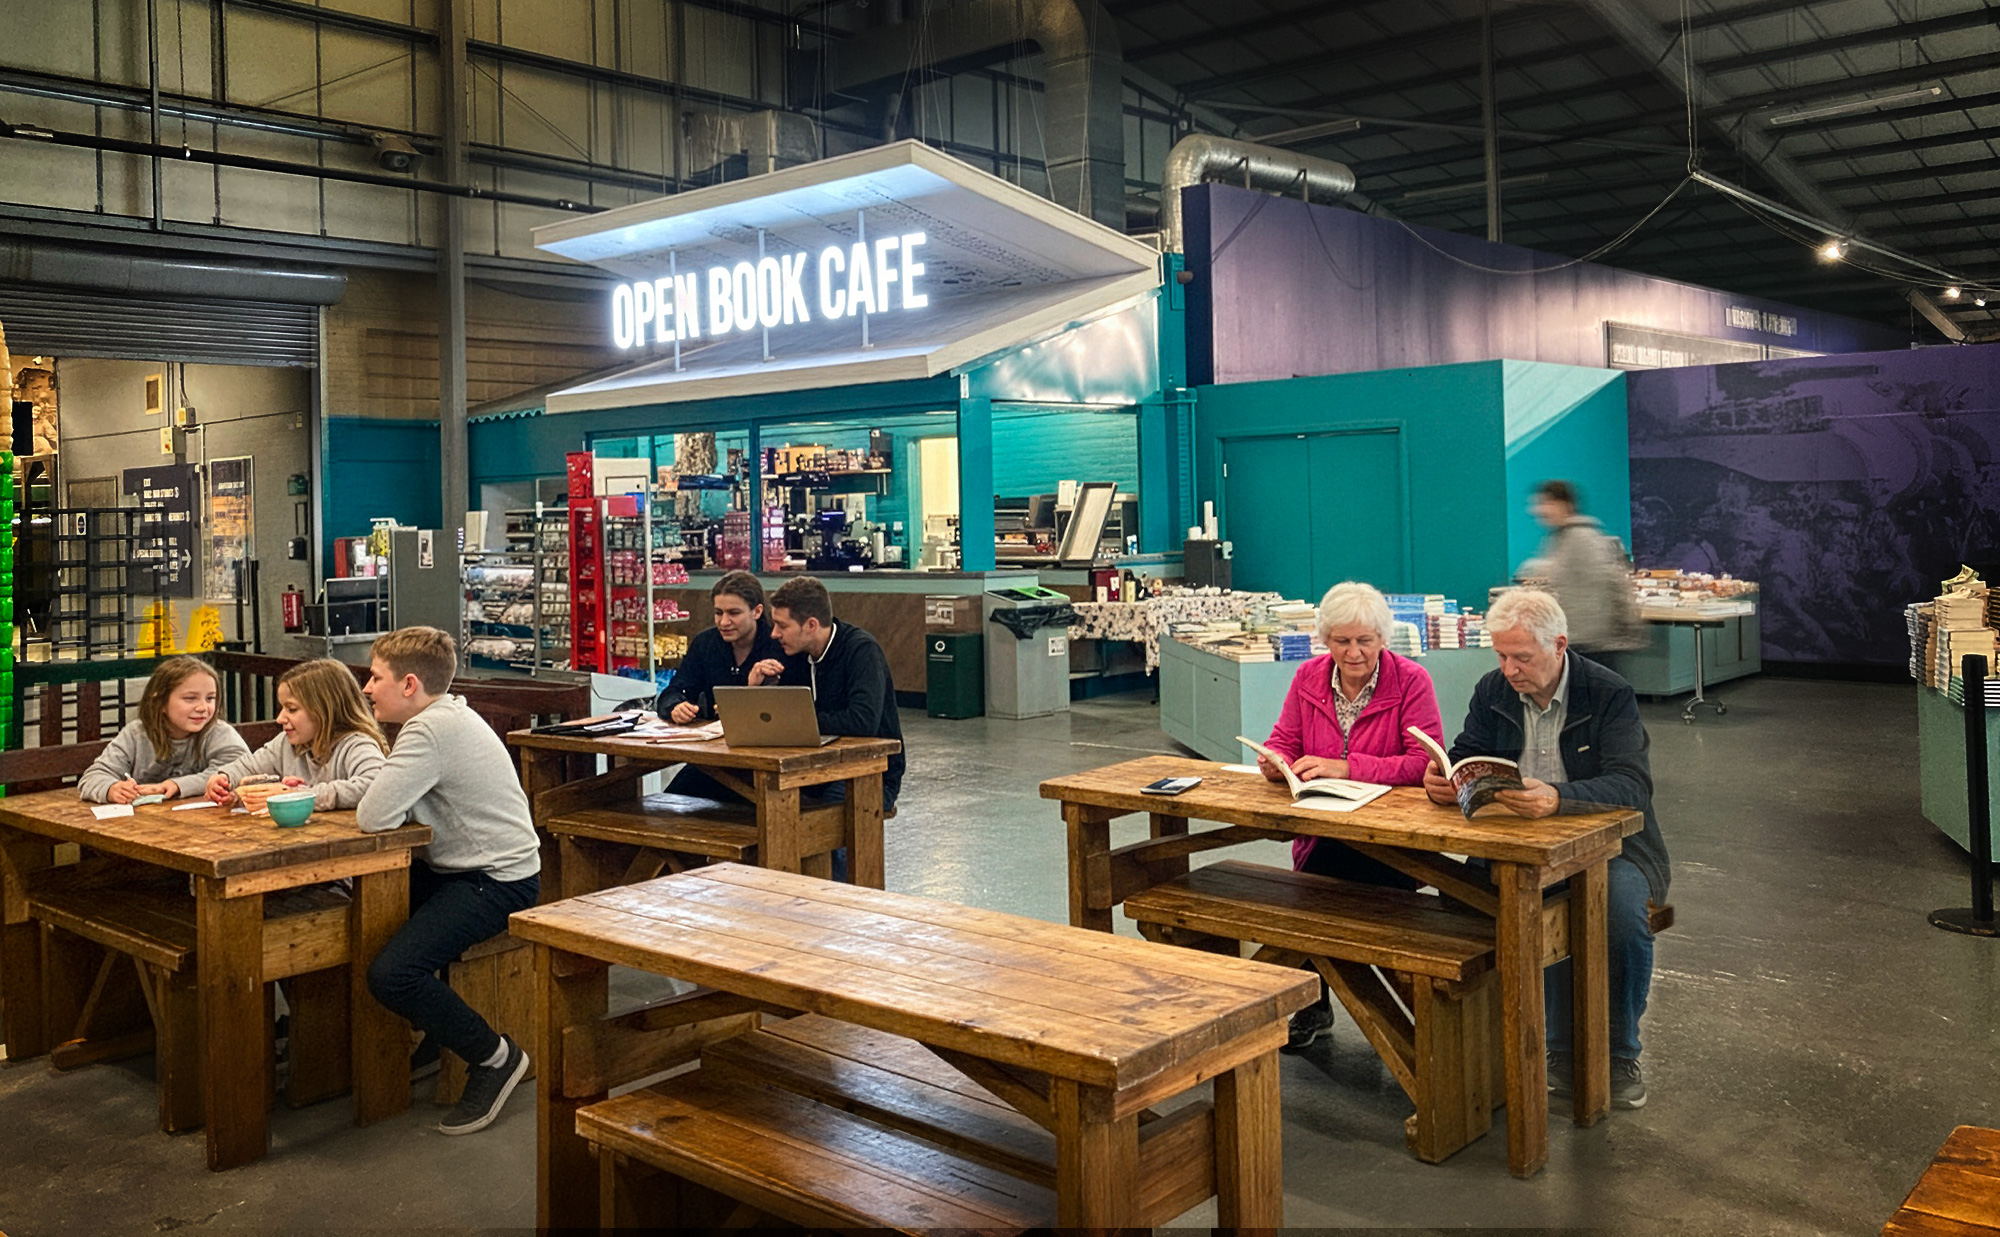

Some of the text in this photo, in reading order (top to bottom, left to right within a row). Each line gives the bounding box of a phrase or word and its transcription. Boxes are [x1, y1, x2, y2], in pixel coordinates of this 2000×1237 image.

[612, 272, 699, 350] OPEN
[709, 252, 810, 335] BOOK
[819, 232, 929, 320] CAFE
